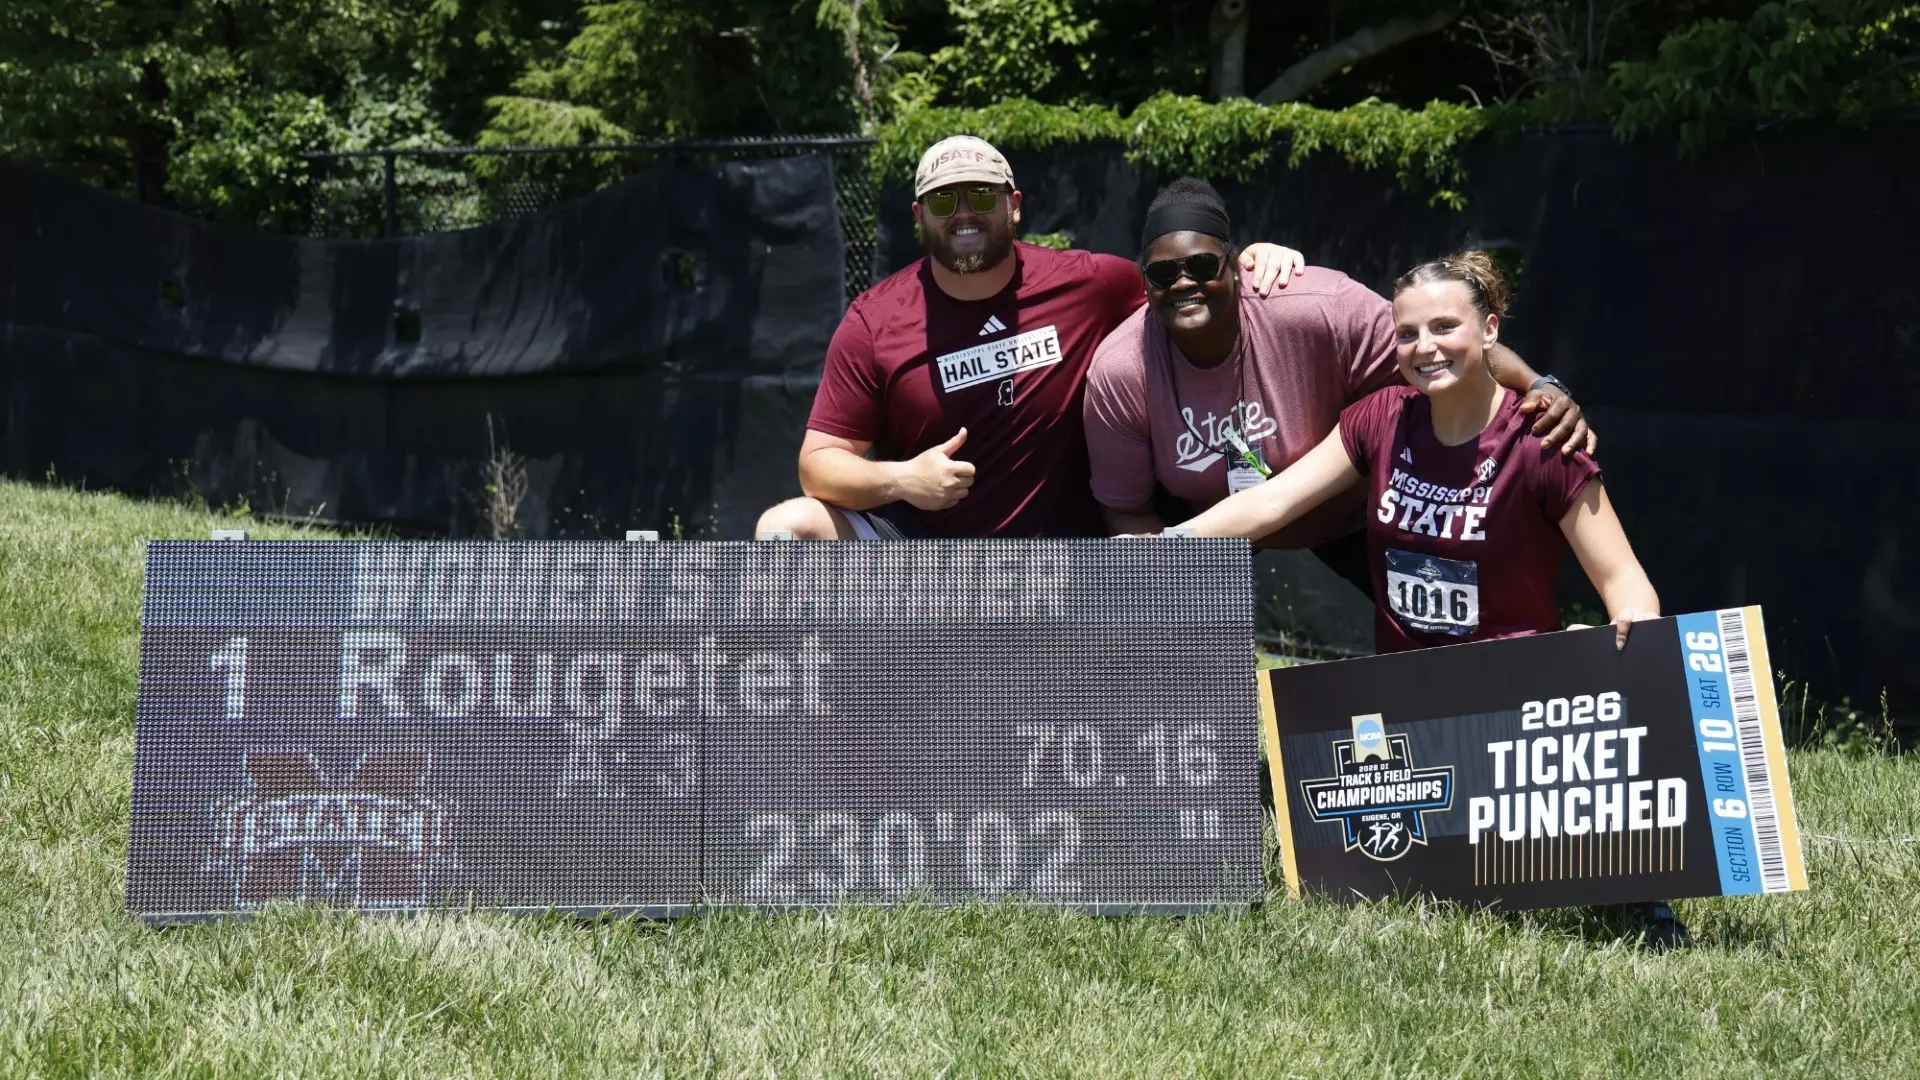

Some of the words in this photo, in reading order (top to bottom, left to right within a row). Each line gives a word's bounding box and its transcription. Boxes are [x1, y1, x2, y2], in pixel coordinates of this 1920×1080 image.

[931, 148, 983, 173] USATF
[943, 357, 990, 383] HAIL
[994, 337, 1056, 369] STATE
[1389, 468, 1492, 504] MISSISSIPPI
[1377, 488, 1487, 541] STATE
[352, 545, 717, 621] WOMEN'S
[738, 543, 1072, 618] HAMMER
[1397, 581, 1468, 621] 1016
[1685, 631, 1723, 673] 26
[210, 637, 248, 720] 1
[339, 630, 832, 741] Rougetet
[1699, 678, 1720, 709] SEAT
[1521, 691, 1621, 731] 2026
[1016, 722, 1219, 789] 70.16
[1359, 731, 1382, 742] NCAA
[1700, 718, 1736, 753] 10
[657, 732, 698, 798] 3
[1487, 726, 1647, 789] TICKET
[1713, 762, 1735, 793] ROW
[1317, 780, 1442, 810] CHAMPIONSHIPS
[1340, 774, 1372, 787] TRACK
[1374, 773, 1382, 784] &
[1384, 769, 1411, 783] FIELD
[1361, 813, 1390, 822] EUGENE,
[1469, 777, 1687, 844] PUNCHED
[1713, 798, 1747, 819] 6
[745, 811, 1083, 899] 230'02
[1730, 827, 1750, 882] SECTION
